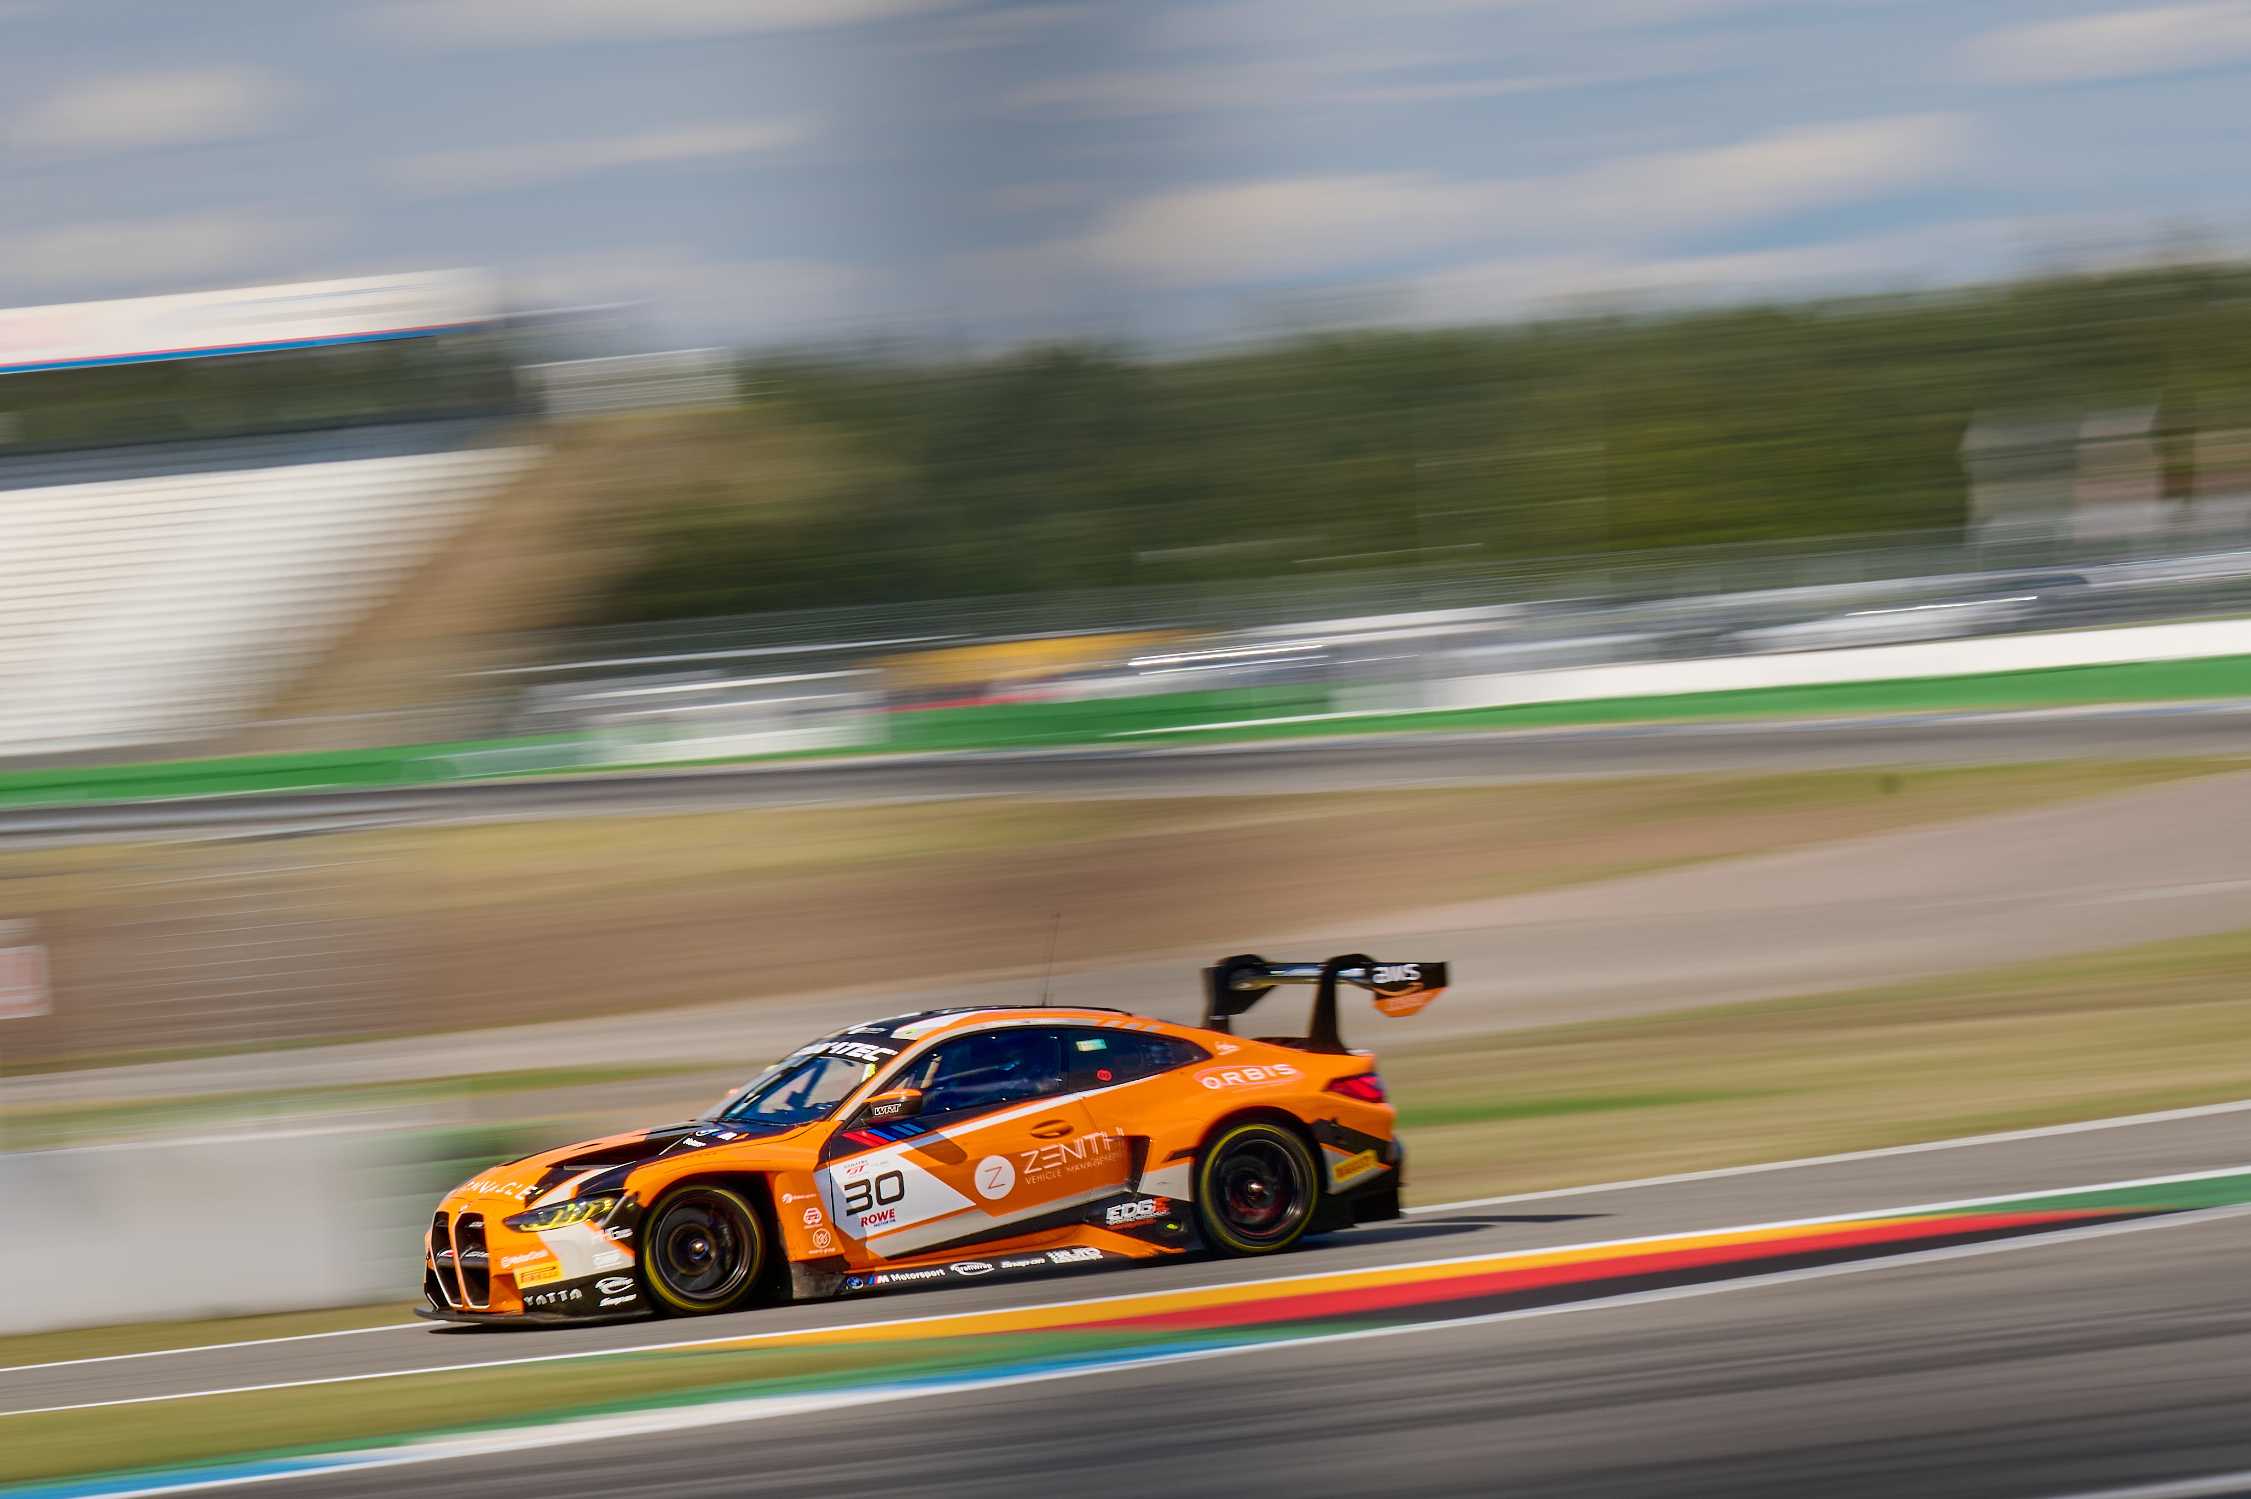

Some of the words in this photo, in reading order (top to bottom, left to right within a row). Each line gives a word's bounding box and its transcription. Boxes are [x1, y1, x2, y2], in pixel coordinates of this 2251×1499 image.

[794, 1041, 899, 1062] ATEC
[1202, 1064, 1297, 1090] ORBIS
[1020, 1126, 1125, 1175] ZENITH
[984, 1166, 1006, 1189] Z
[844, 1169, 905, 1216] 30
[860, 1208, 896, 1227] ROWE
[891, 1269, 946, 1282] Motorsport
[523, 1288, 583, 1306] YATTA
